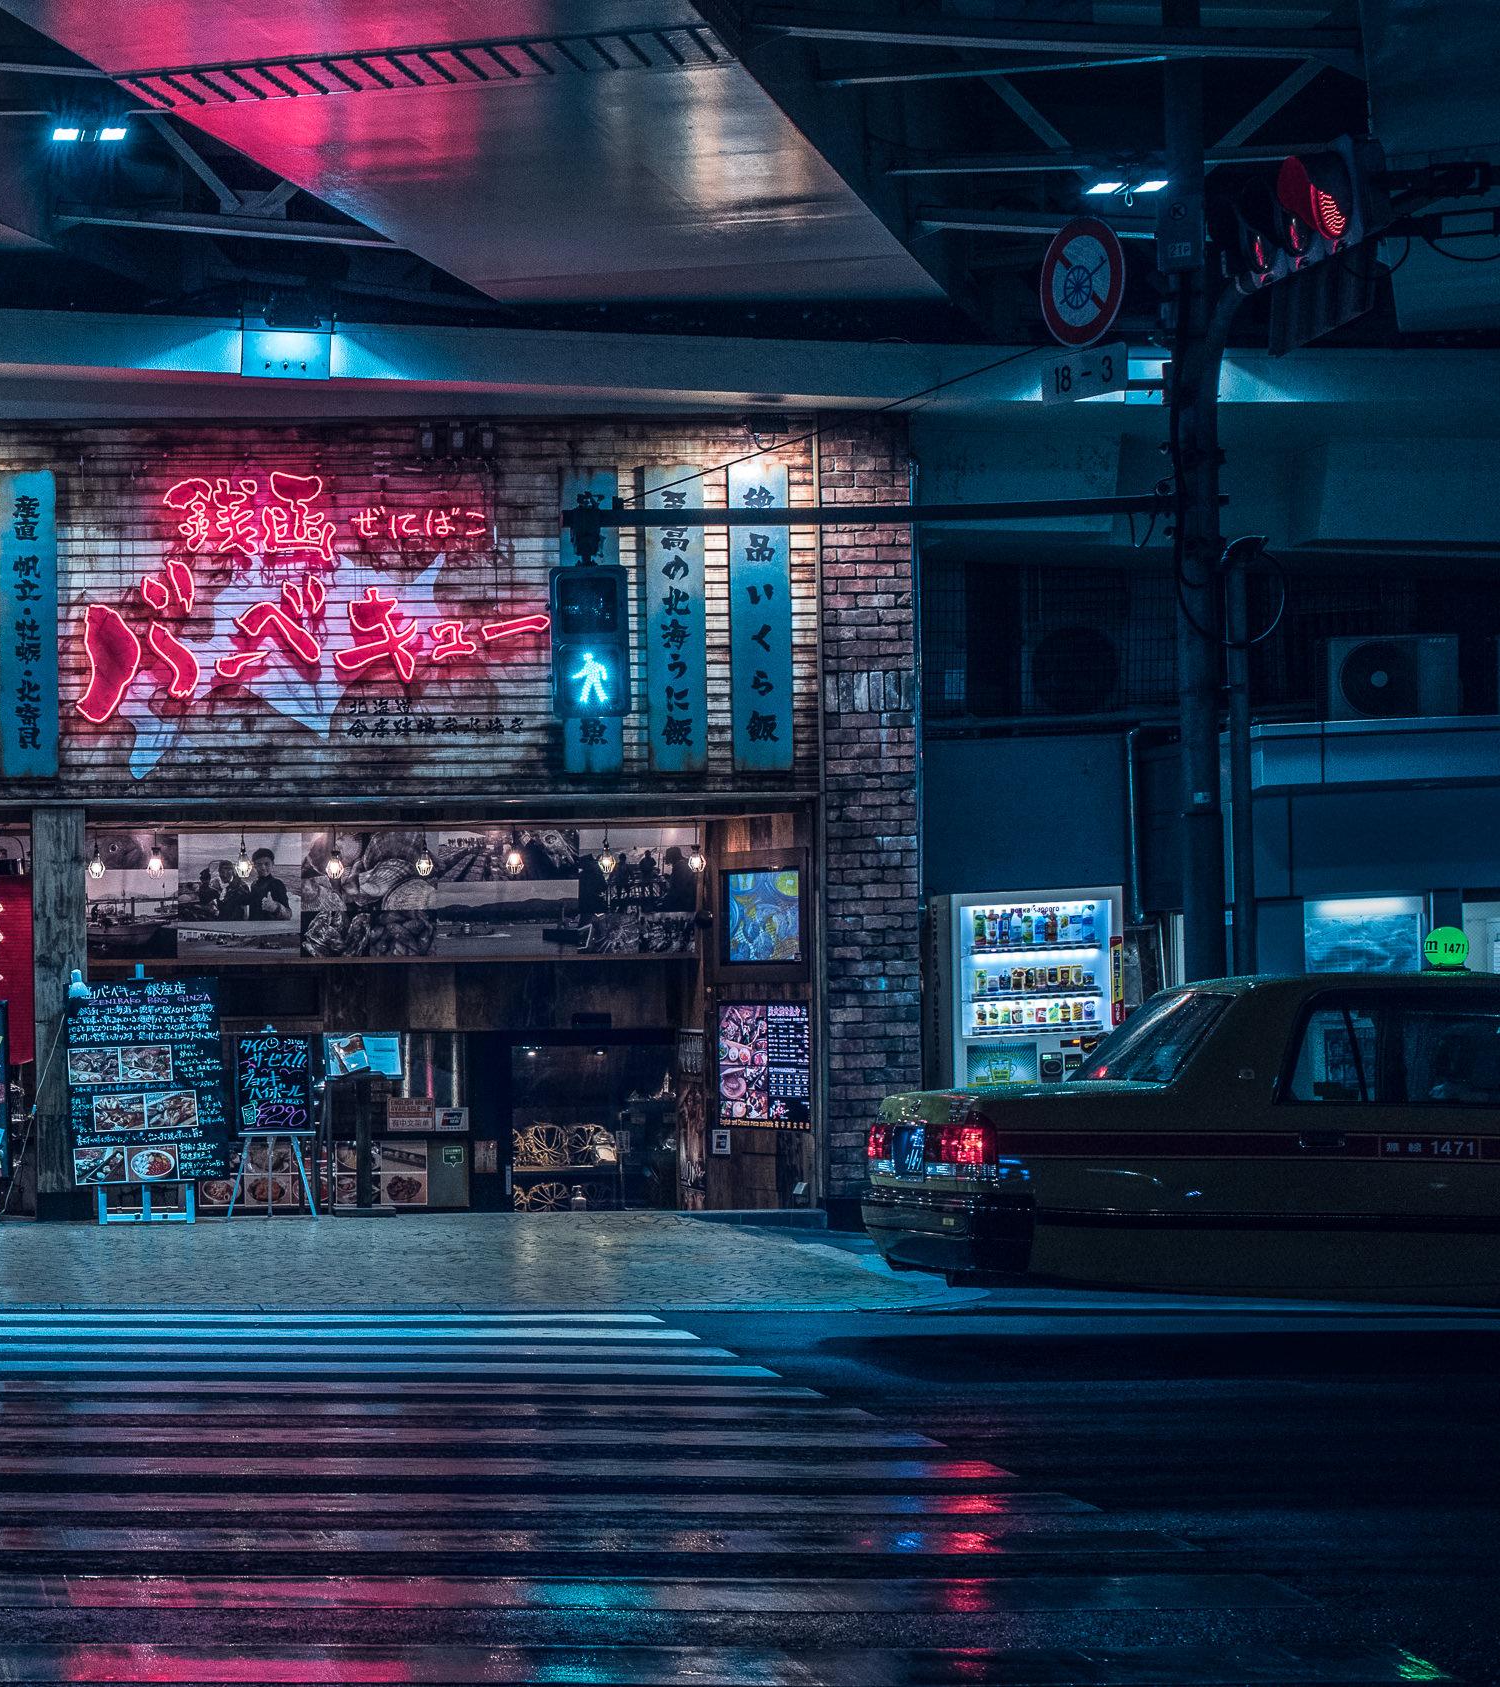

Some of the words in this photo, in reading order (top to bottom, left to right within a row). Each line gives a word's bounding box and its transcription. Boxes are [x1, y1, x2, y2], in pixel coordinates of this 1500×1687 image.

[350, 505, 486, 539] ぜにばこ
[74, 560, 551, 724] バーベキュー
[1443, 943, 1466, 954] 1471
[177, 993, 211, 1003] GINZA
[240, 1038, 267, 1054] タイム
[248, 1083, 306, 1100] ハイボール
[1430, 1140, 1475, 1155] 1471
